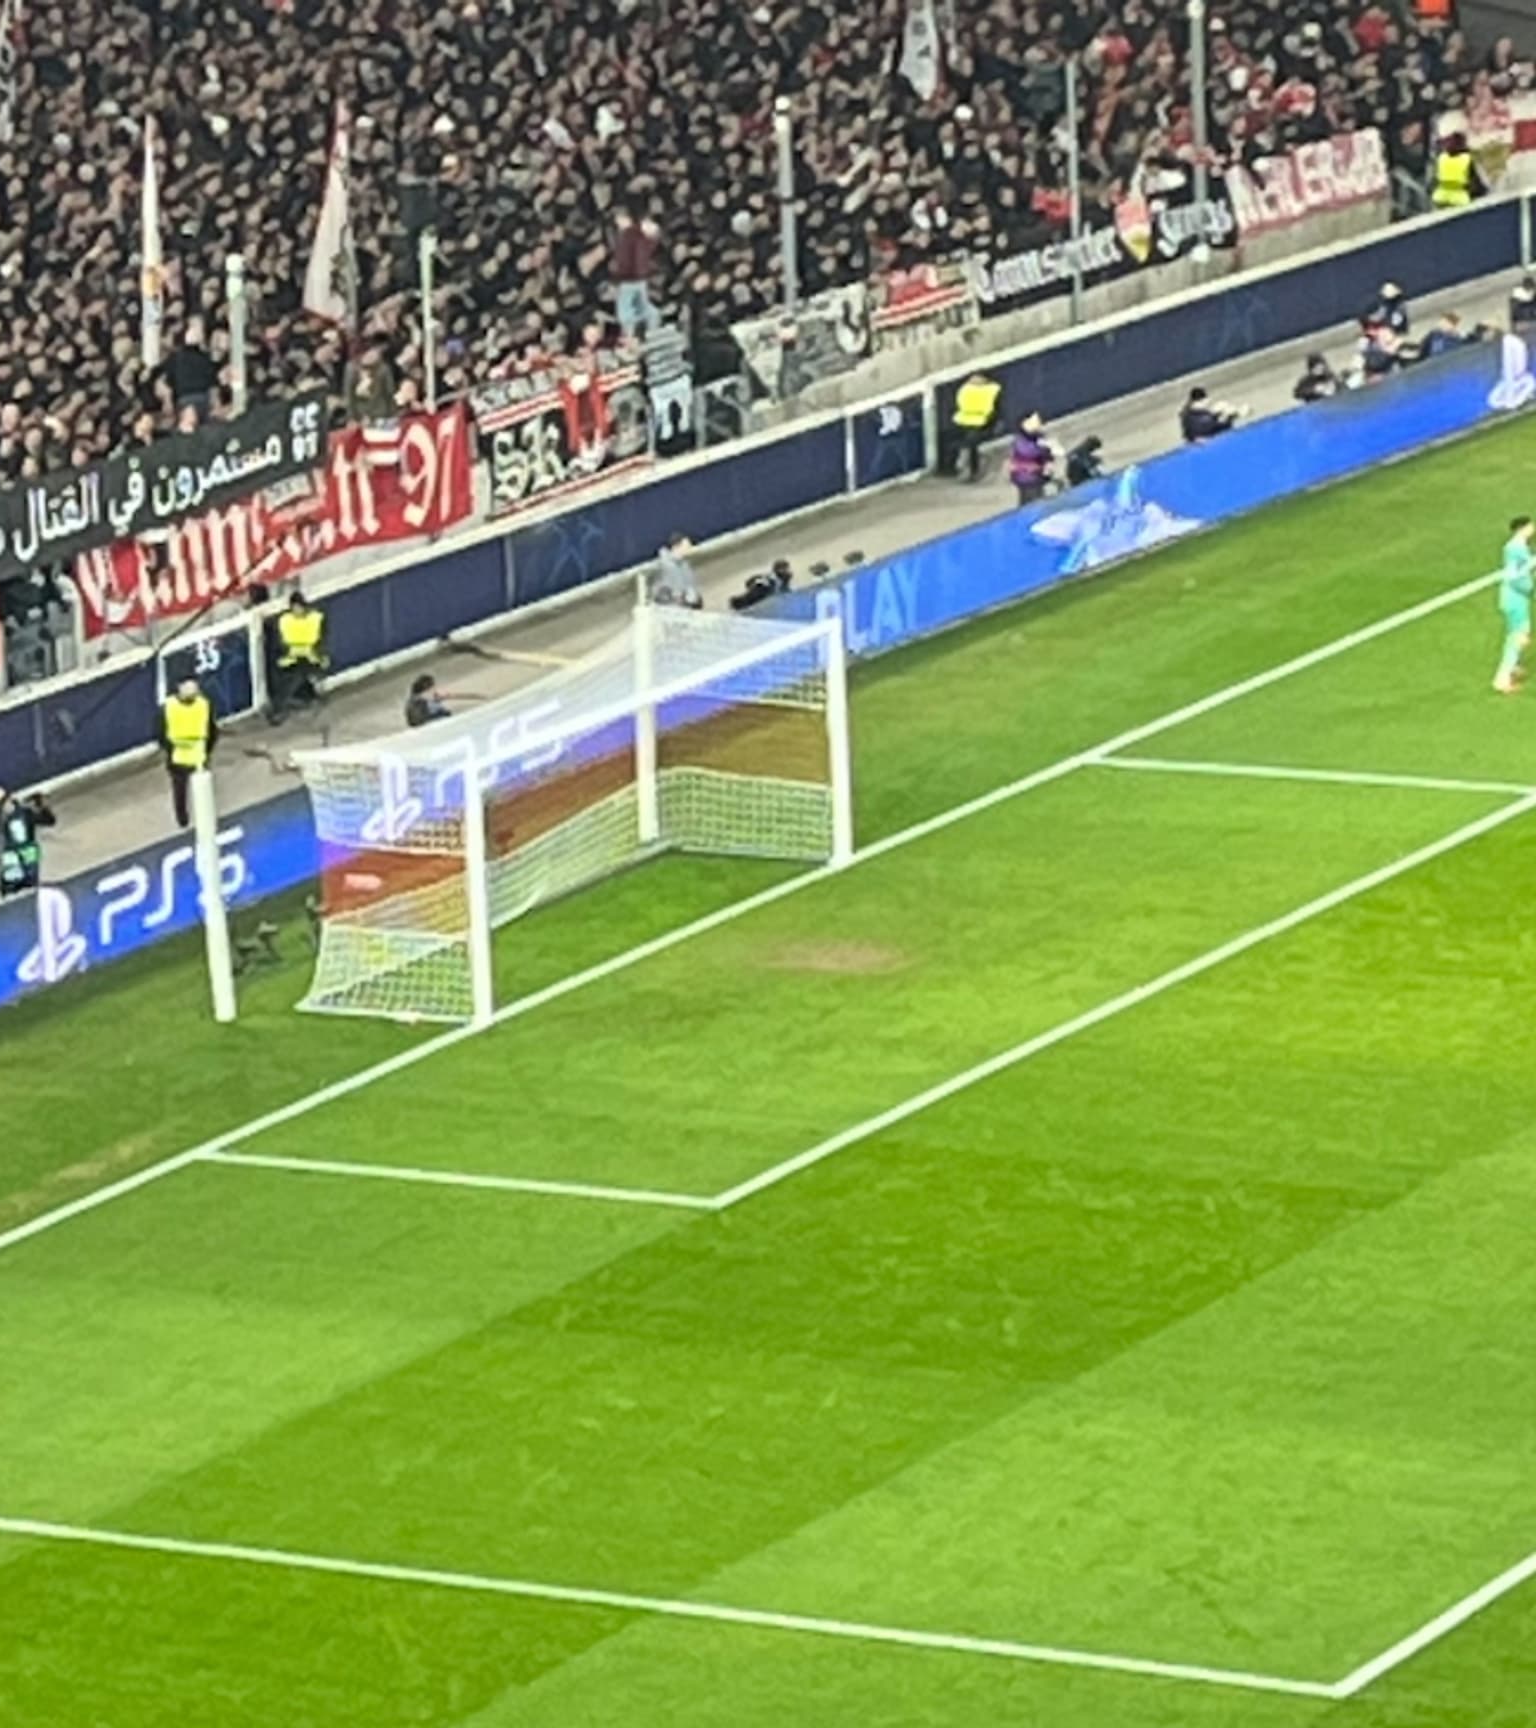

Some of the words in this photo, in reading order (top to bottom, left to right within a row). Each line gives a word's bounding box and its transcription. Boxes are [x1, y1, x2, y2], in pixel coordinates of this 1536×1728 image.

[108, 457, 145, 537] في
[152, 434, 282, 516] مستمرون
[399, 405, 458, 527] 97
[12, 471, 100, 562] القتال
[96, 825, 245, 945] PS5
